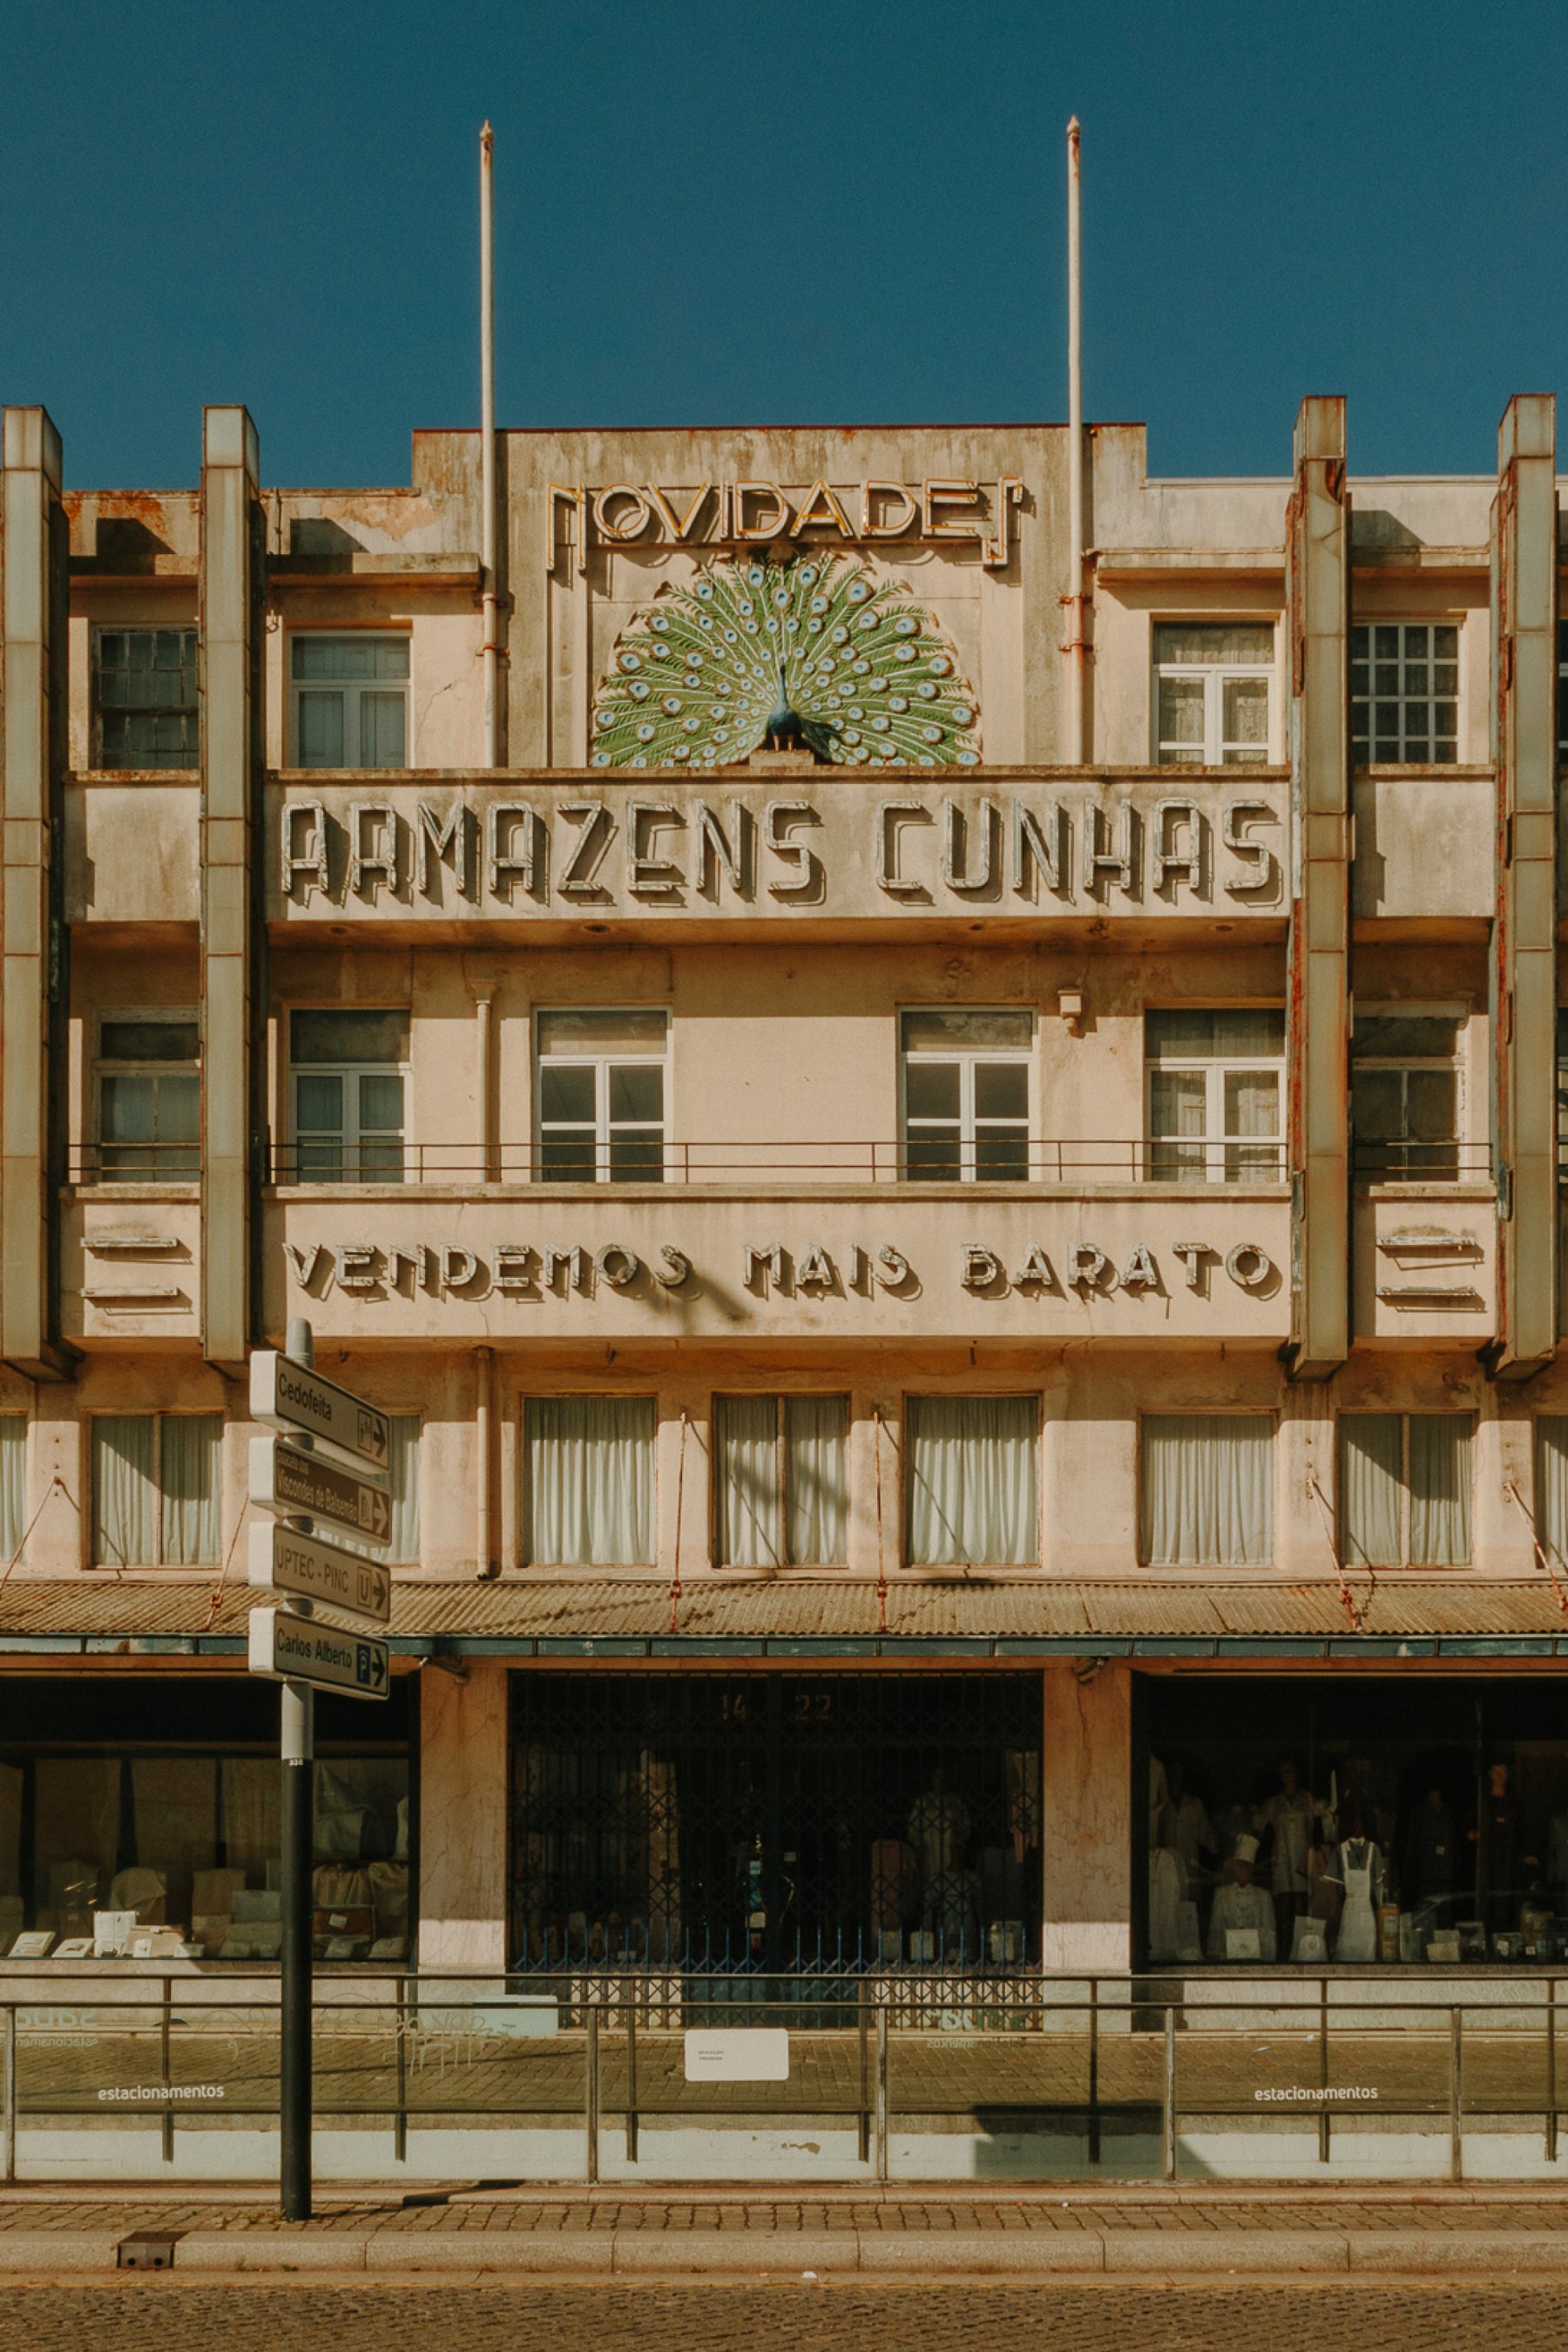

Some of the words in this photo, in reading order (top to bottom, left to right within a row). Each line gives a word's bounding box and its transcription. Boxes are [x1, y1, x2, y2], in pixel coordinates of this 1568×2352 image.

[546, 476, 1023, 571] NOVIDADES
[281, 799, 812, 893] ARMAZENS
[876, 797, 1270, 891] CUNHAS
[282, 1242, 688, 1288] VENDEMOS
[742, 1242, 909, 1287] MAIS
[961, 1242, 1270, 1287] BARATO
[279, 1373, 333, 1421] Cedofeita
[278, 1468, 314, 1505] Viscondes
[315, 1484, 325, 1510] de
[276, 1544, 315, 1580] UPTEC
[324, 1564, 349, 1593] PINC
[277, 1627, 312, 1659] Carlos
[315, 1639, 353, 1669] Alberto
[98, 2085, 226, 2101] estacionamentos
[1254, 2085, 1379, 2102] estacionamentos
